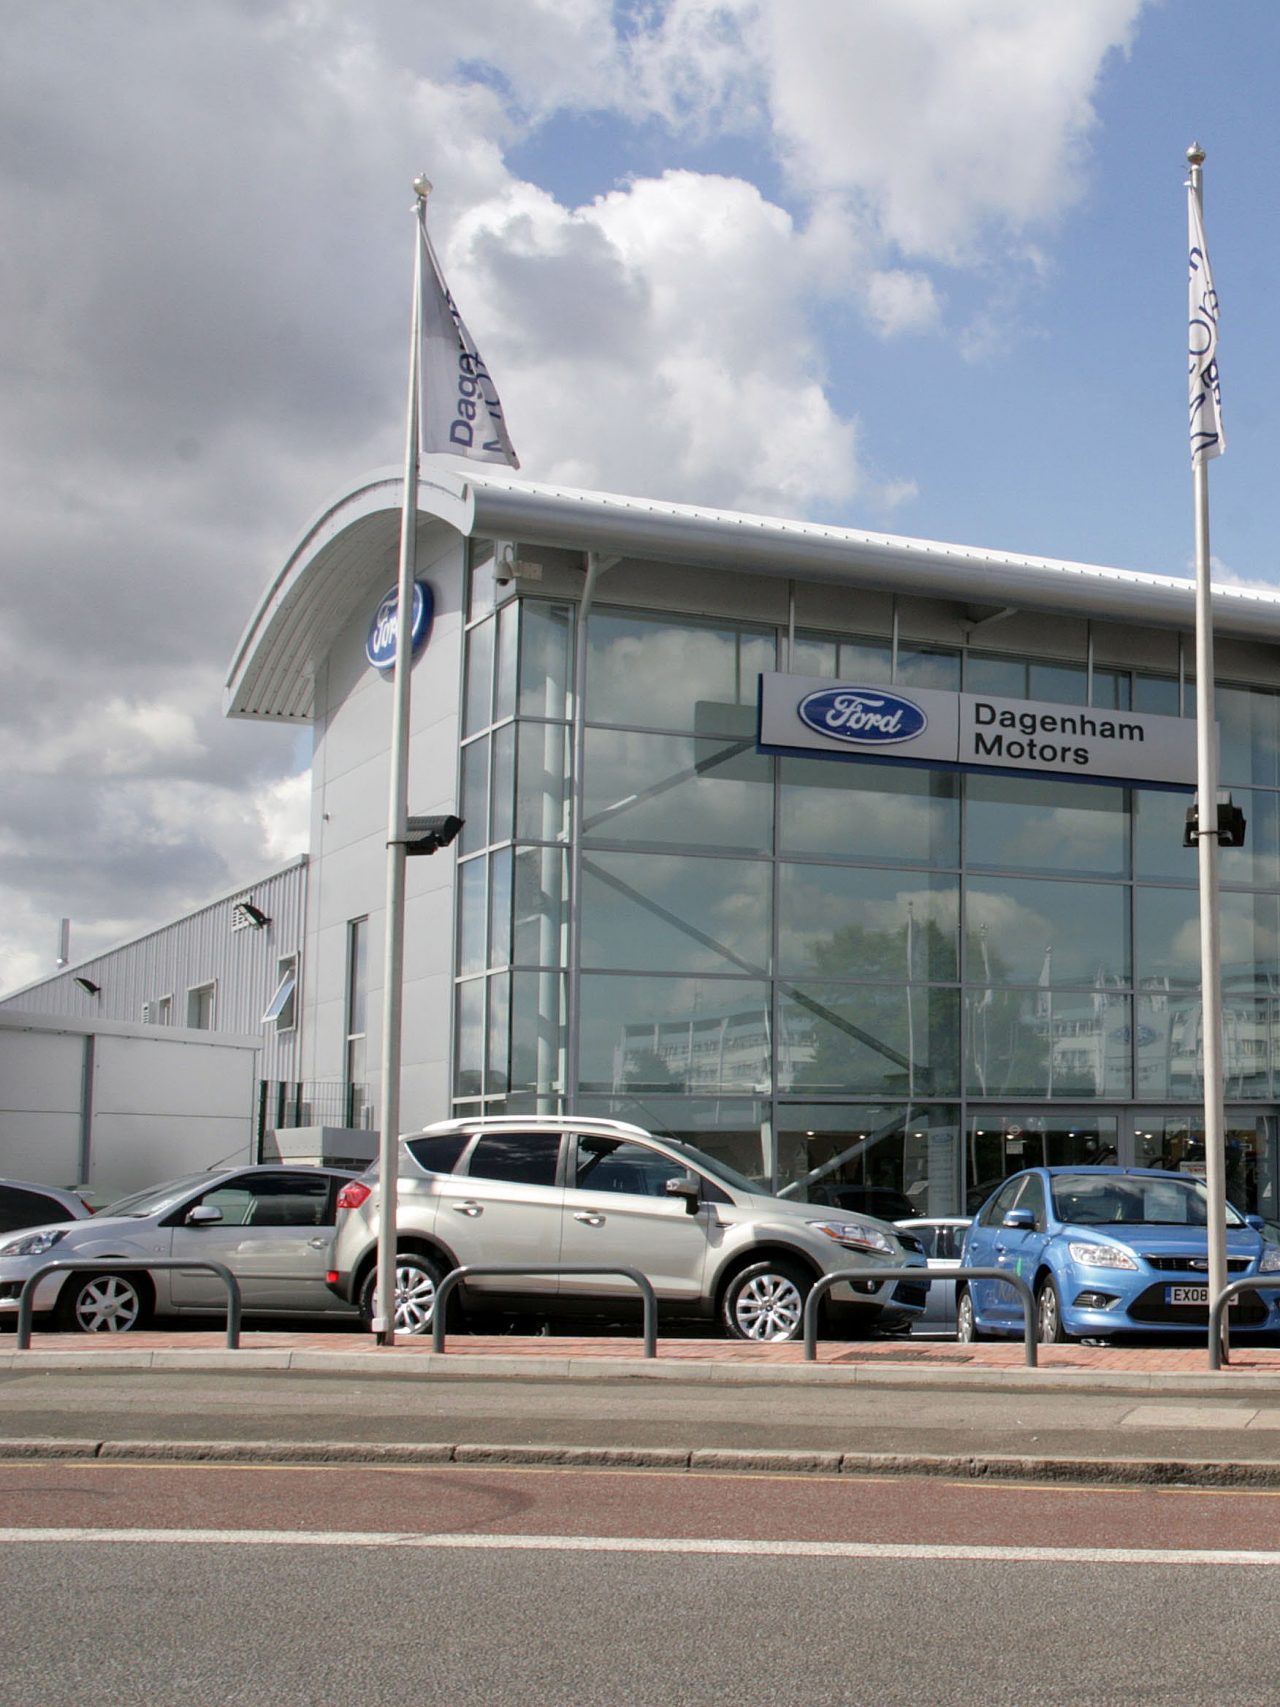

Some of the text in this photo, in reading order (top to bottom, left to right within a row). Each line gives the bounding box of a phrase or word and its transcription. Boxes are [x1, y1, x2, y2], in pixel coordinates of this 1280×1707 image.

[373, 597, 399, 654] For
[826, 695, 903, 733] Ford
[975, 703, 1144, 742] Dagenham
[974, 732, 1089, 765] Motors
[1174, 1289, 1208, 1302] EX08
